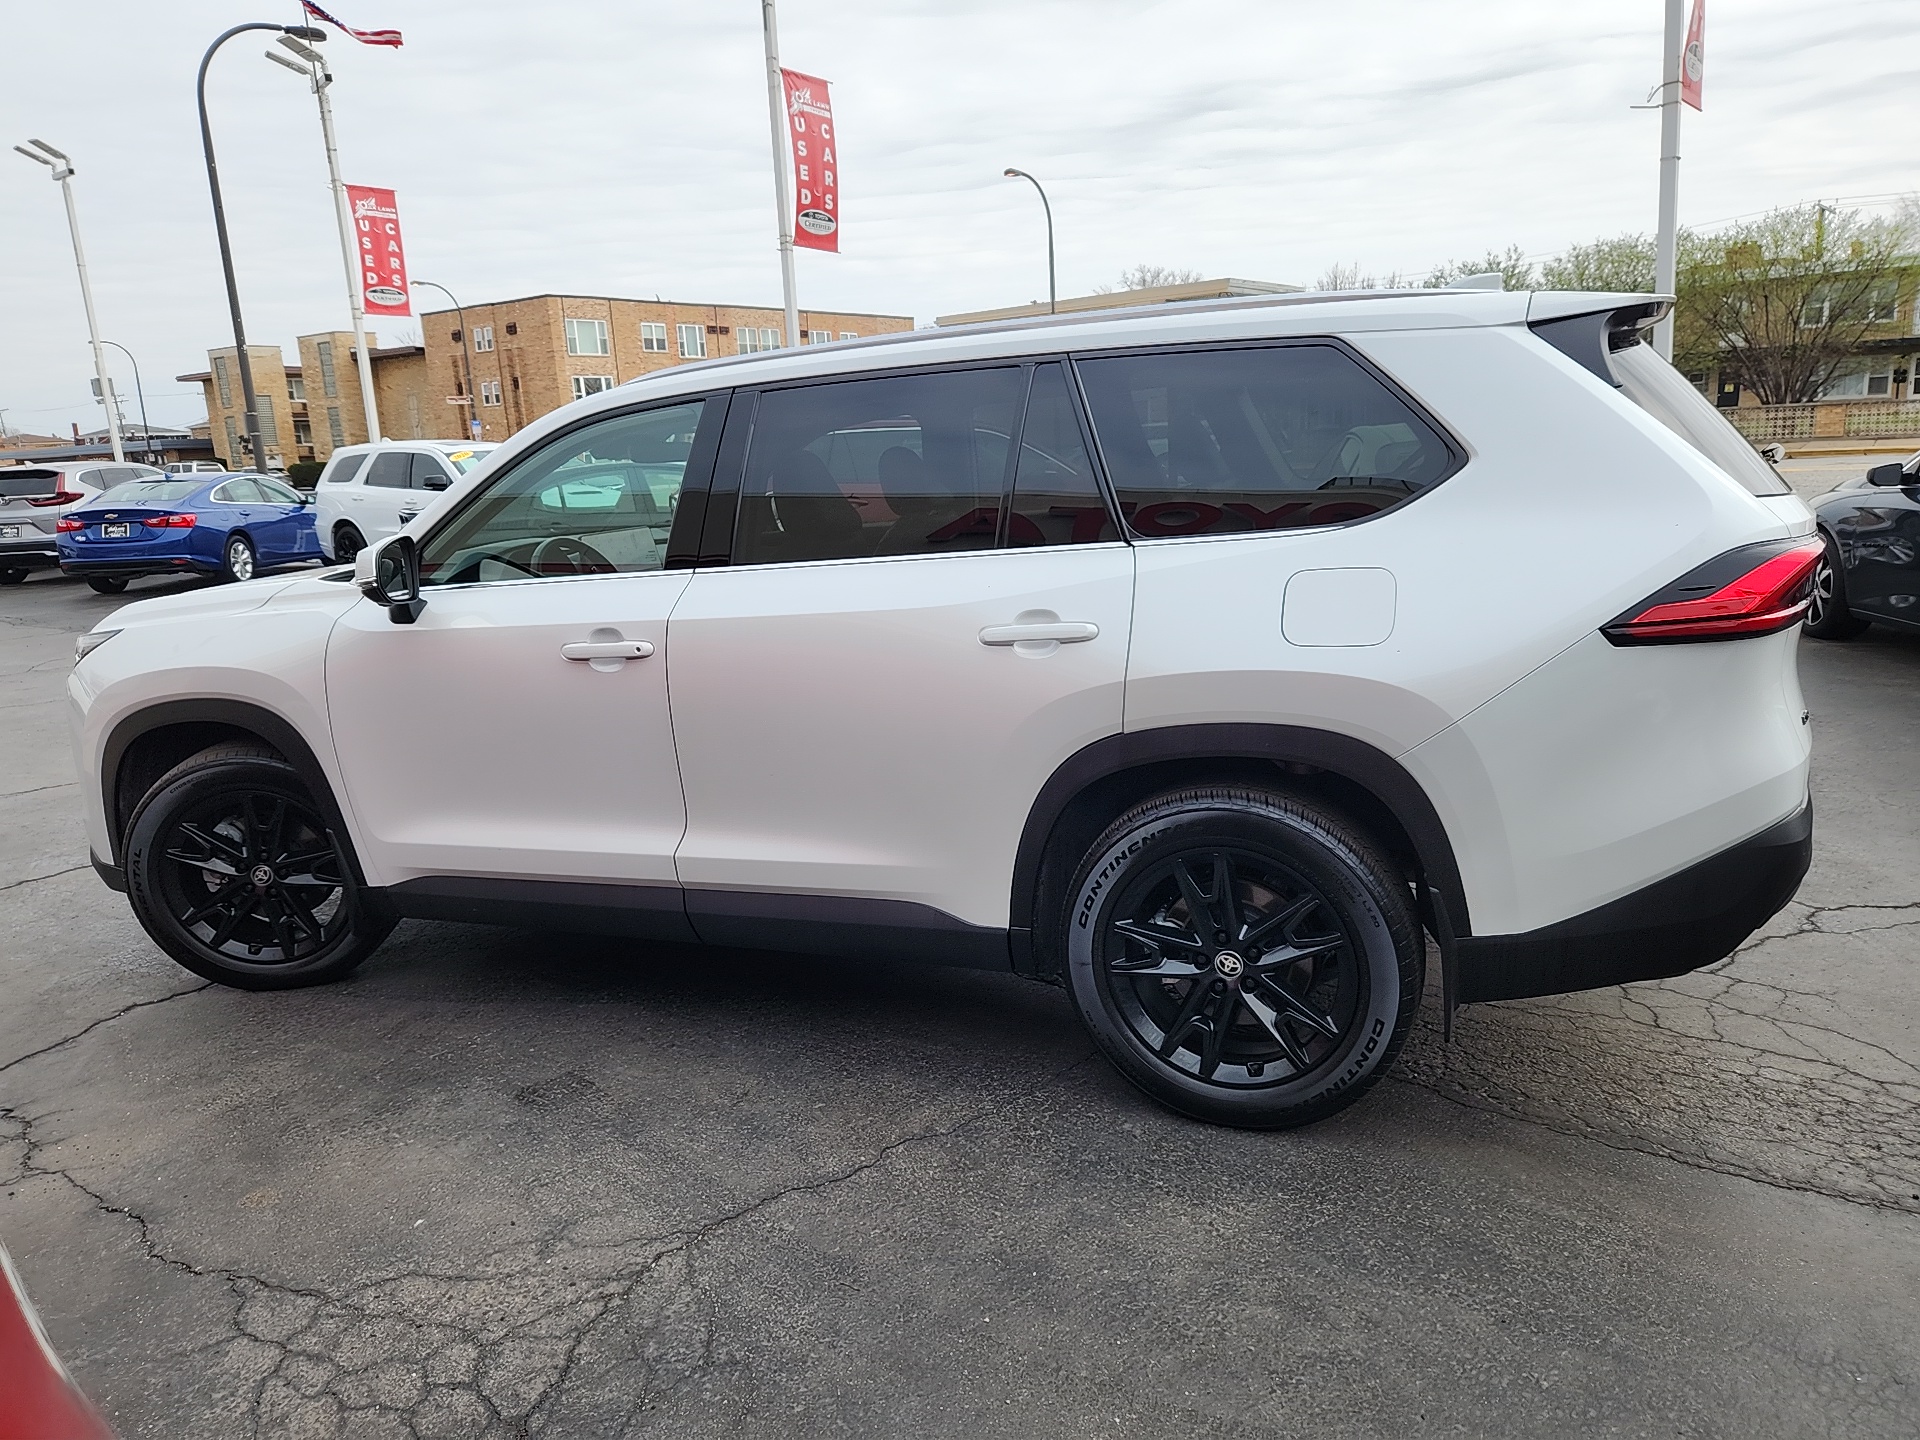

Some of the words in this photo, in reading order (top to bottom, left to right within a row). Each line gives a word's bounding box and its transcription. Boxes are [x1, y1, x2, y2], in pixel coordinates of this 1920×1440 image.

[794, 117, 812, 205] USED
[821, 123, 834, 211] CARS
[359, 219, 378, 285] USED
[385, 222, 402, 287] CARS
